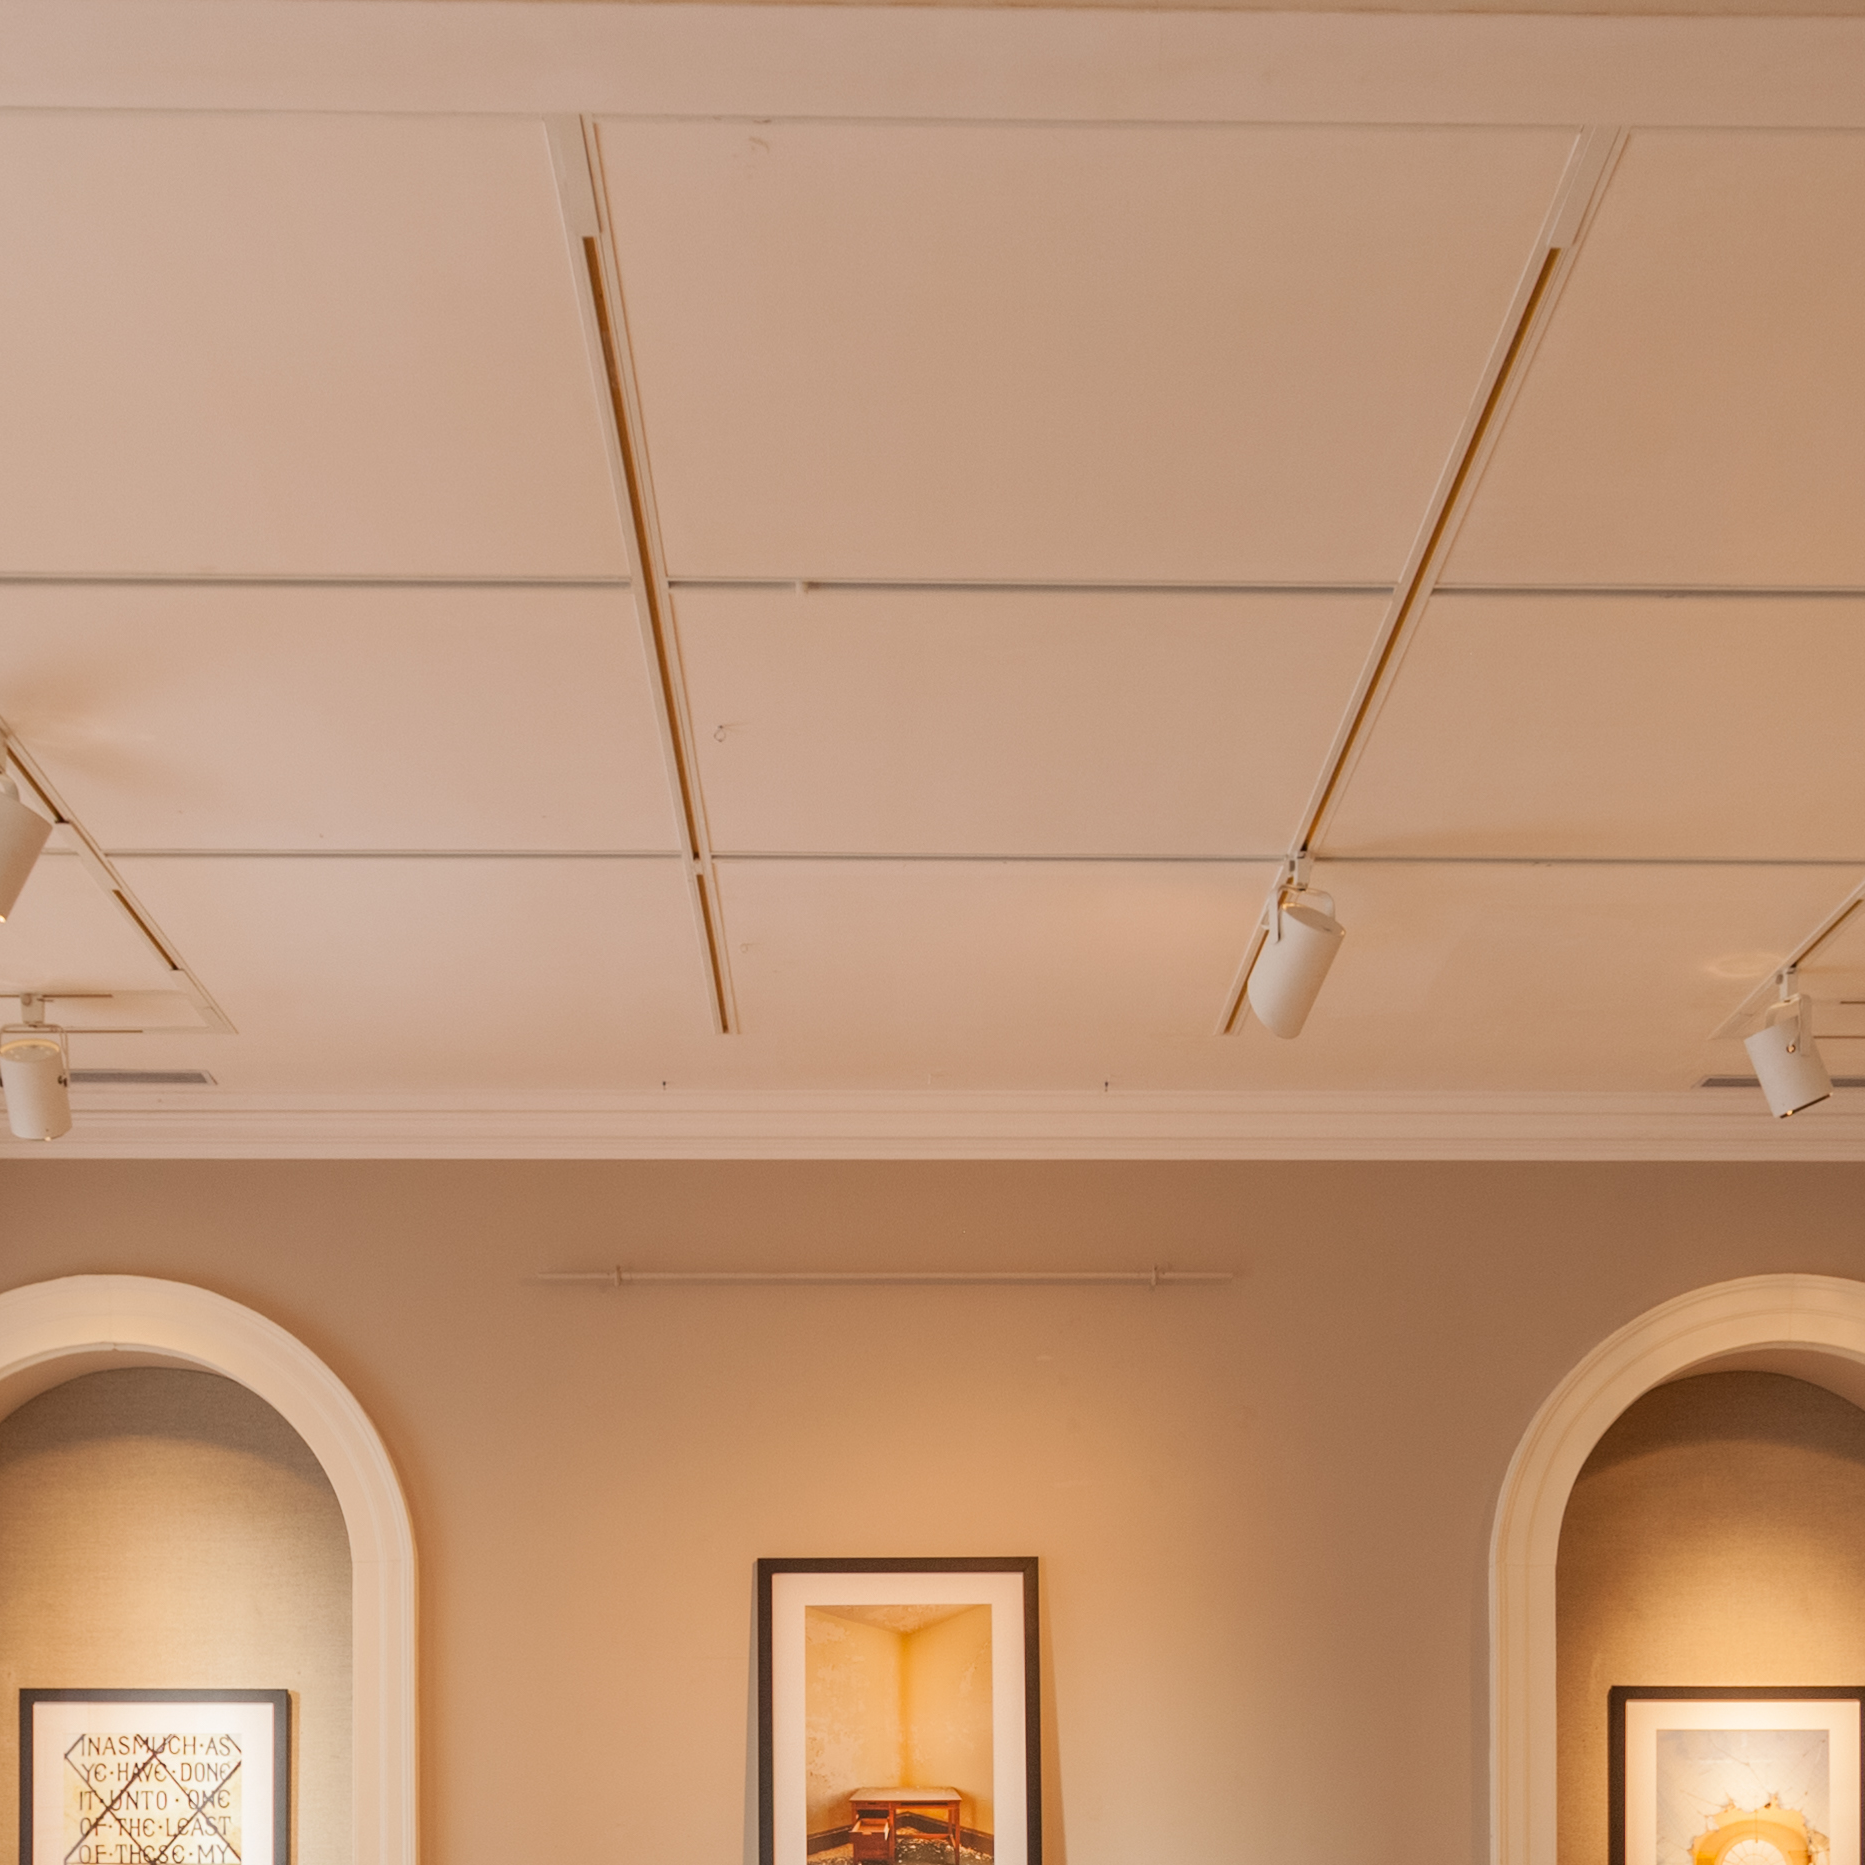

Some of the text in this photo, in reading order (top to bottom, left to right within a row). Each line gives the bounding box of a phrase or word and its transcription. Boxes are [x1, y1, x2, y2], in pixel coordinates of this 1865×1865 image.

[82, 1735, 230, 1756] INASMUCH AS
[82, 1762, 230, 1782] YE HAVE DONE
[80, 1790, 230, 1811] IT UNTO ONE
[80, 1816, 233, 1837] OF THE LEAST
[79, 1844, 229, 1864] OF THESE MY
